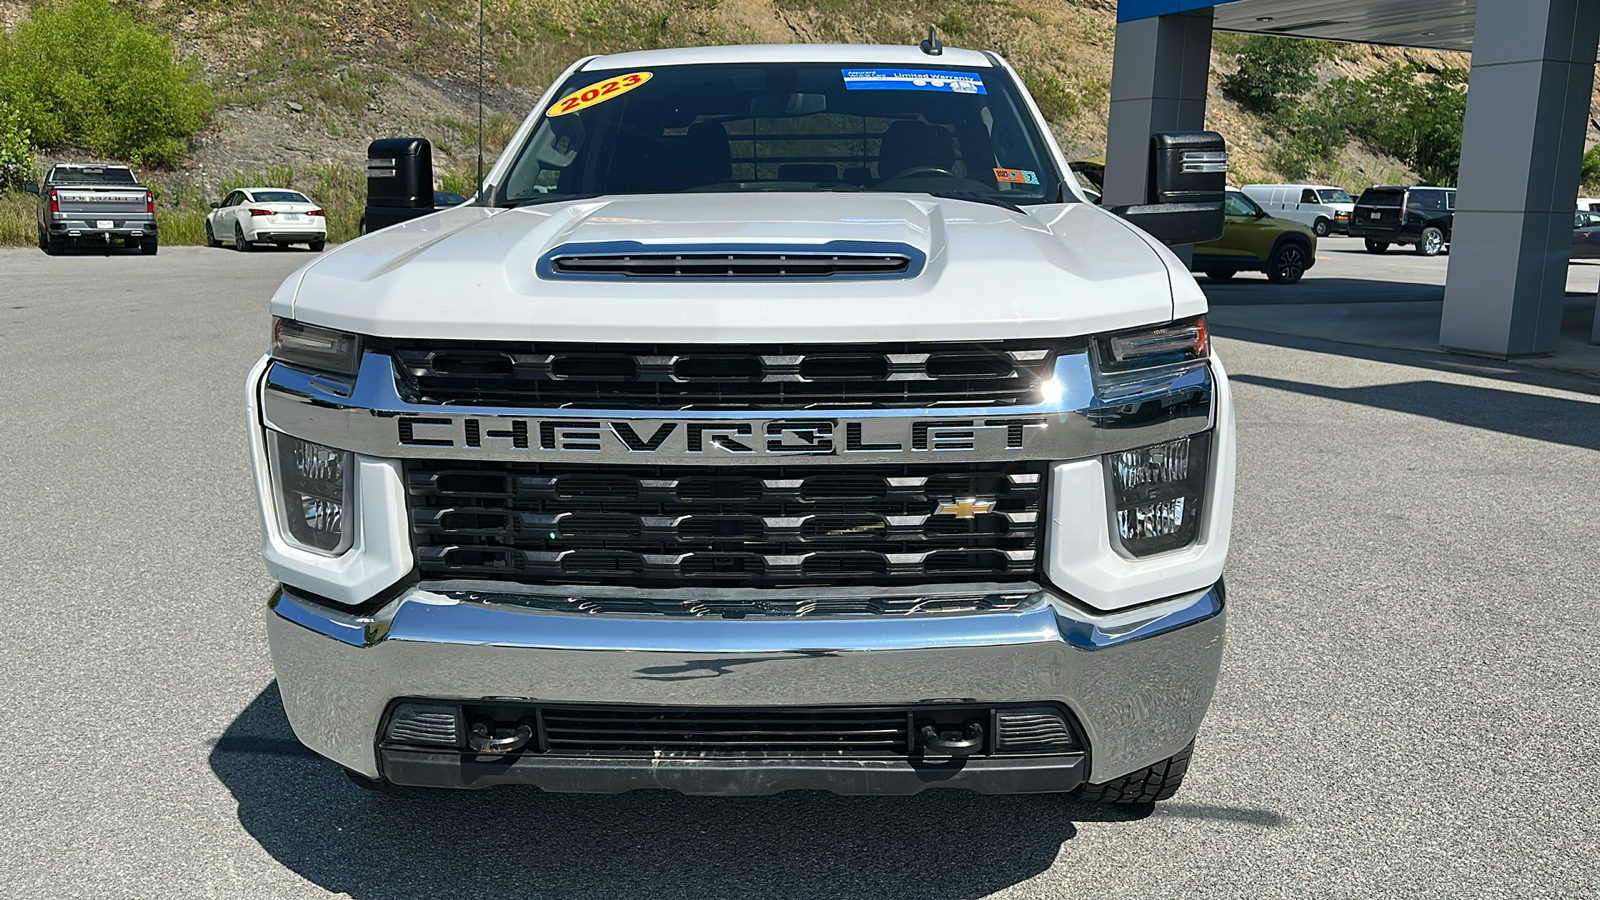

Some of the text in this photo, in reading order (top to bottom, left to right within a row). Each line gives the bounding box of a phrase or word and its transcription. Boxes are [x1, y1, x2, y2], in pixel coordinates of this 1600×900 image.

[561, 75, 642, 112] 2023
[930, 74, 974, 82] Warranty
[397, 417, 1048, 454] CHEVROLET
